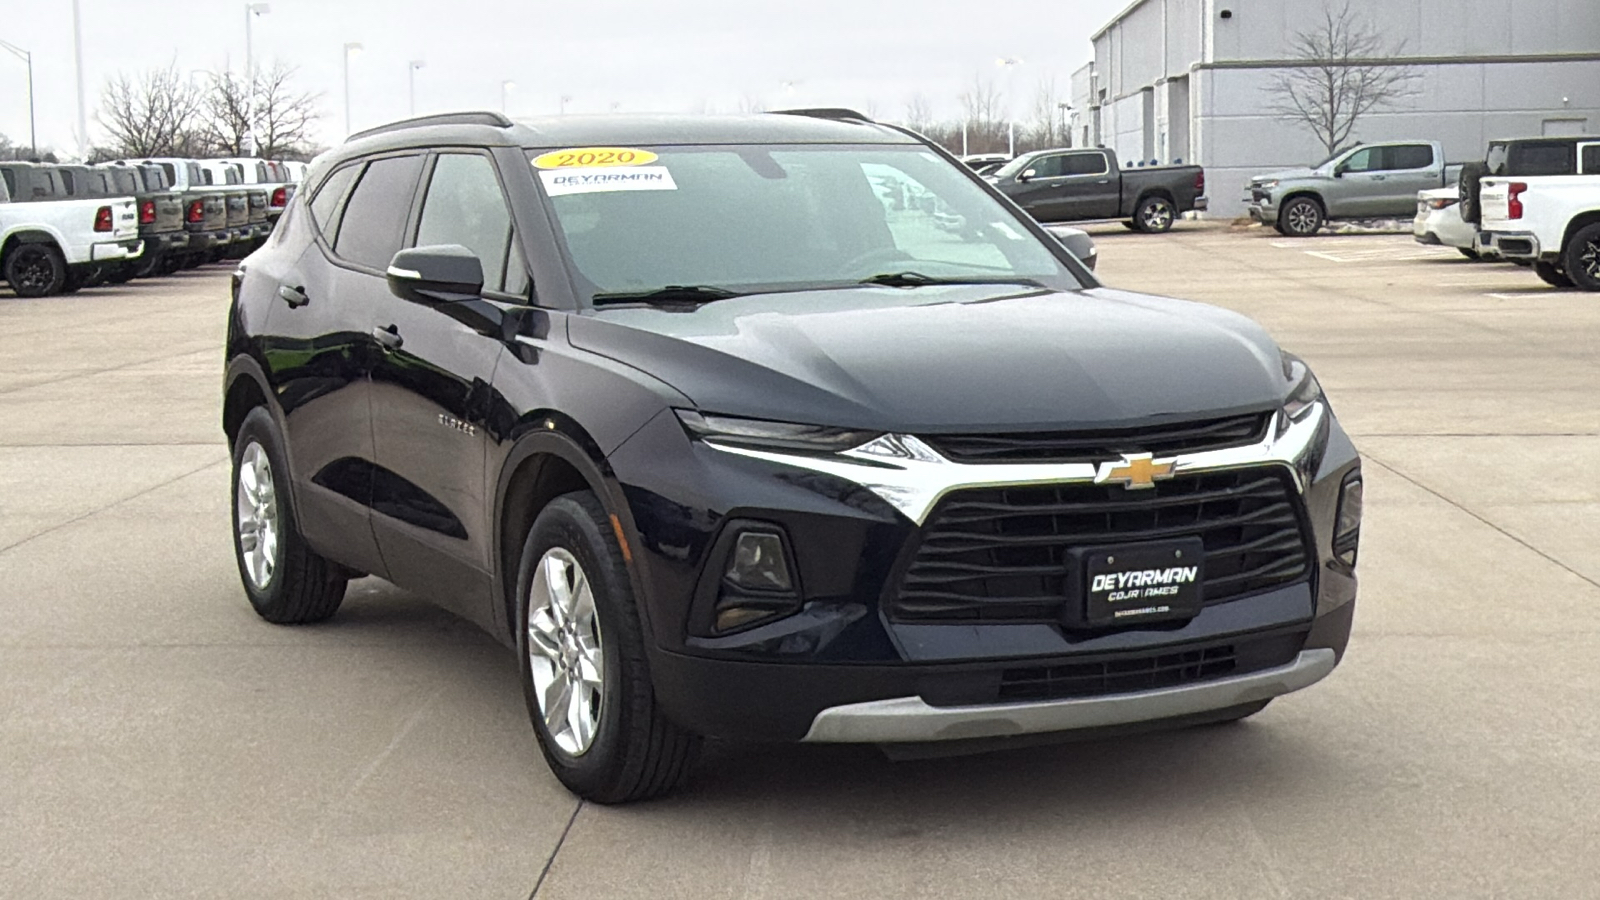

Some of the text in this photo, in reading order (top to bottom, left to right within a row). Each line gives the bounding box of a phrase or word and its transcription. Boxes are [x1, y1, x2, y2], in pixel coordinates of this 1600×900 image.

[557, 151, 636, 167] 2020
[553, 172, 663, 185] DEYARMAN
[1091, 565, 1198, 593] DEYARMAN
[1143, 584, 1179, 598] AMES
